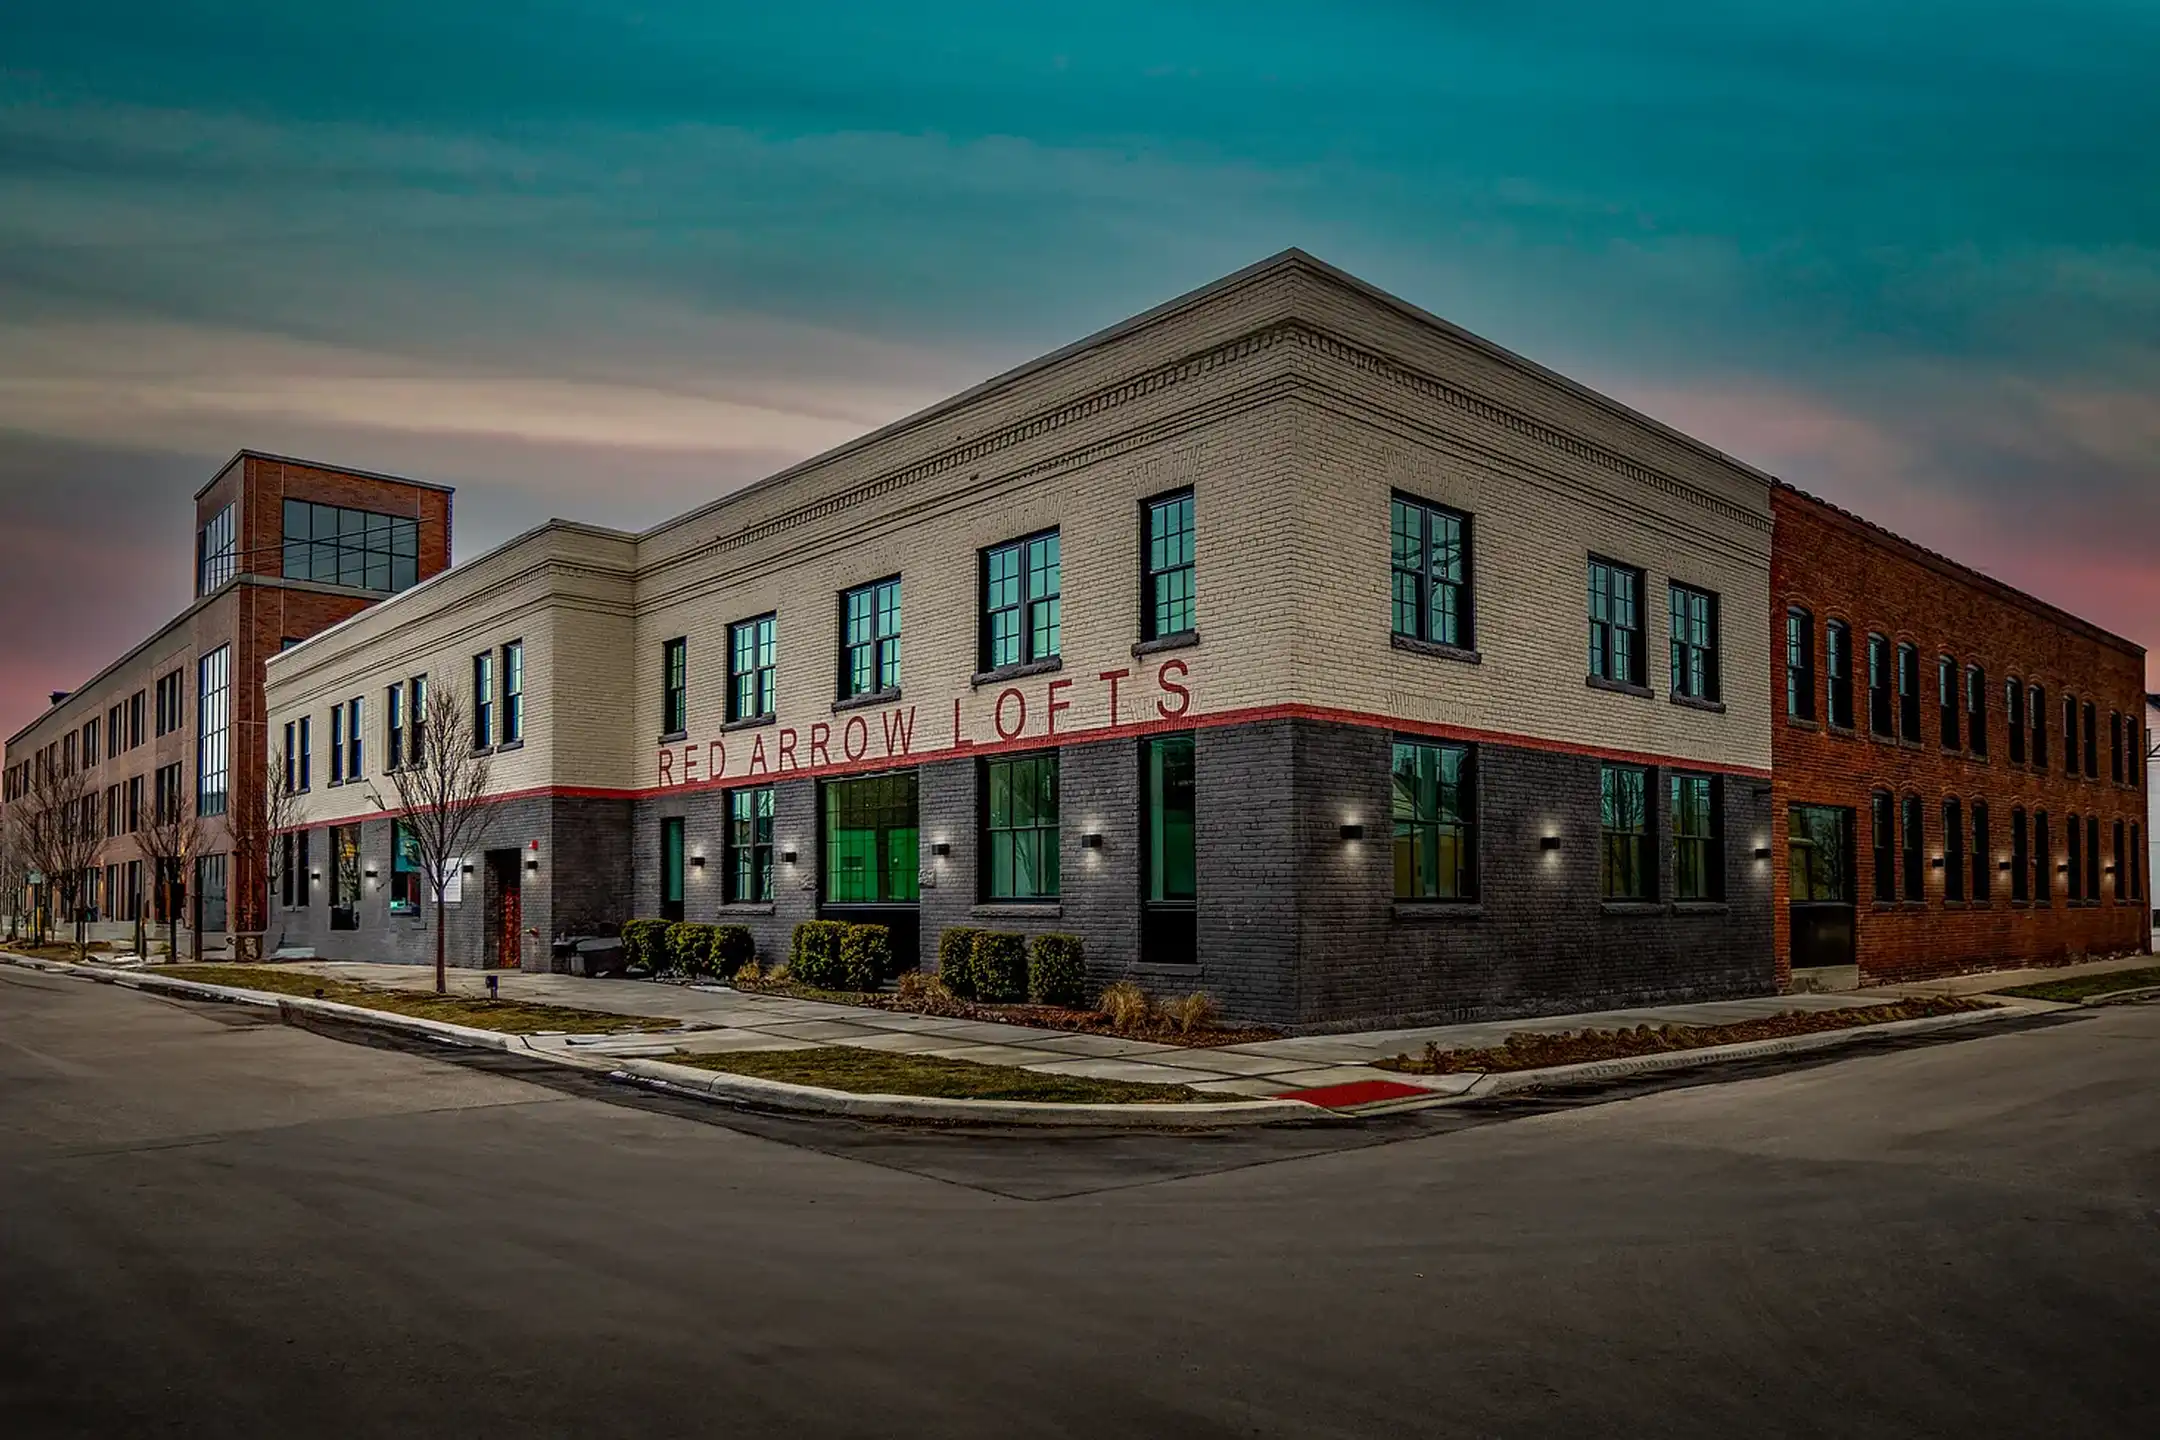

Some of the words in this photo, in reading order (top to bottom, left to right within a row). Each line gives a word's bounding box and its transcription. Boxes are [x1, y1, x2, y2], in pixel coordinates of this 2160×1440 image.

[657, 740, 727, 788] RED
[750, 706, 916, 776] ARROW
[953, 659, 1191, 748] LOFTS
